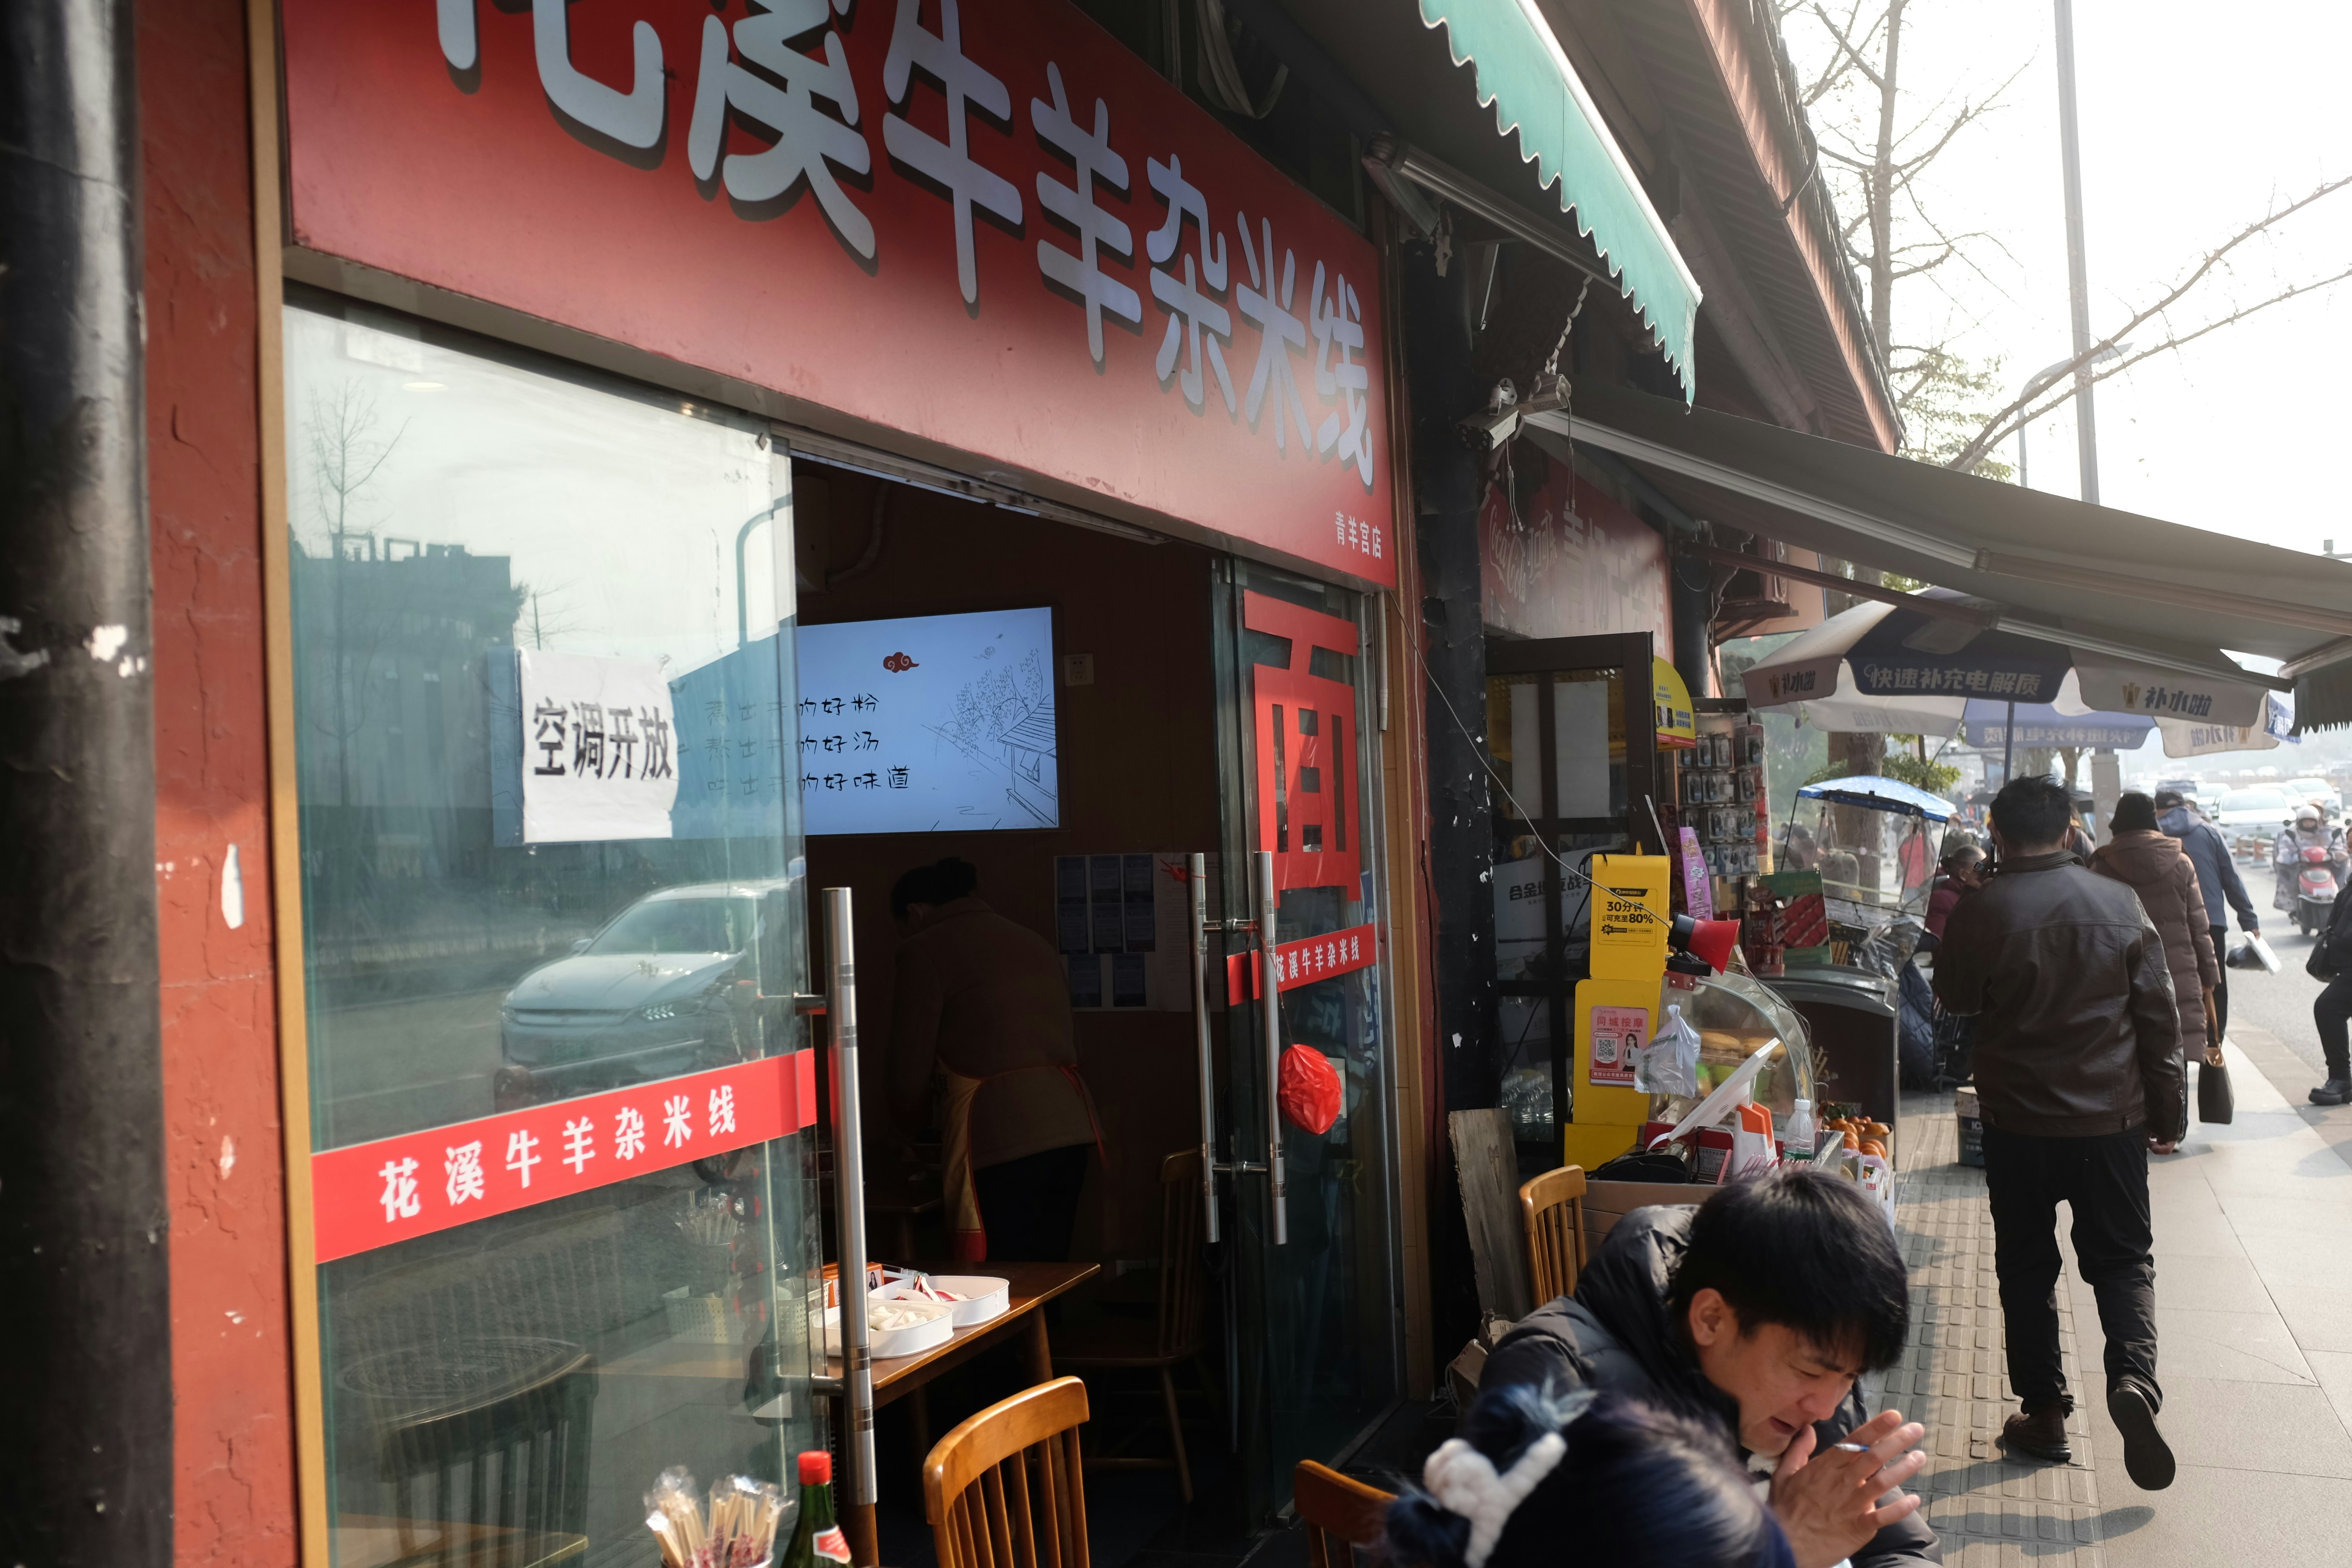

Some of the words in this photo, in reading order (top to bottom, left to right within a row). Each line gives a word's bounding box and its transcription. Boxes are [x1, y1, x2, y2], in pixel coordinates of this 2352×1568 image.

[1335, 511, 1382, 559] 青羊宫店
[1782, 670, 1816, 695] 补水啦
[1870, 667, 2040, 696] 快速补充电解质
[2145, 686, 2212, 717] 补水啦
[531, 696, 674, 782] 空调开放
[1606, 914, 1653, 923] 可充至80%
[1275, 935, 1360, 983] 花溪牛羊杂米线
[1597, 1016, 1643, 1027] 同城按摩
[379, 1084, 737, 1224] 花溪牛羊杂米线
